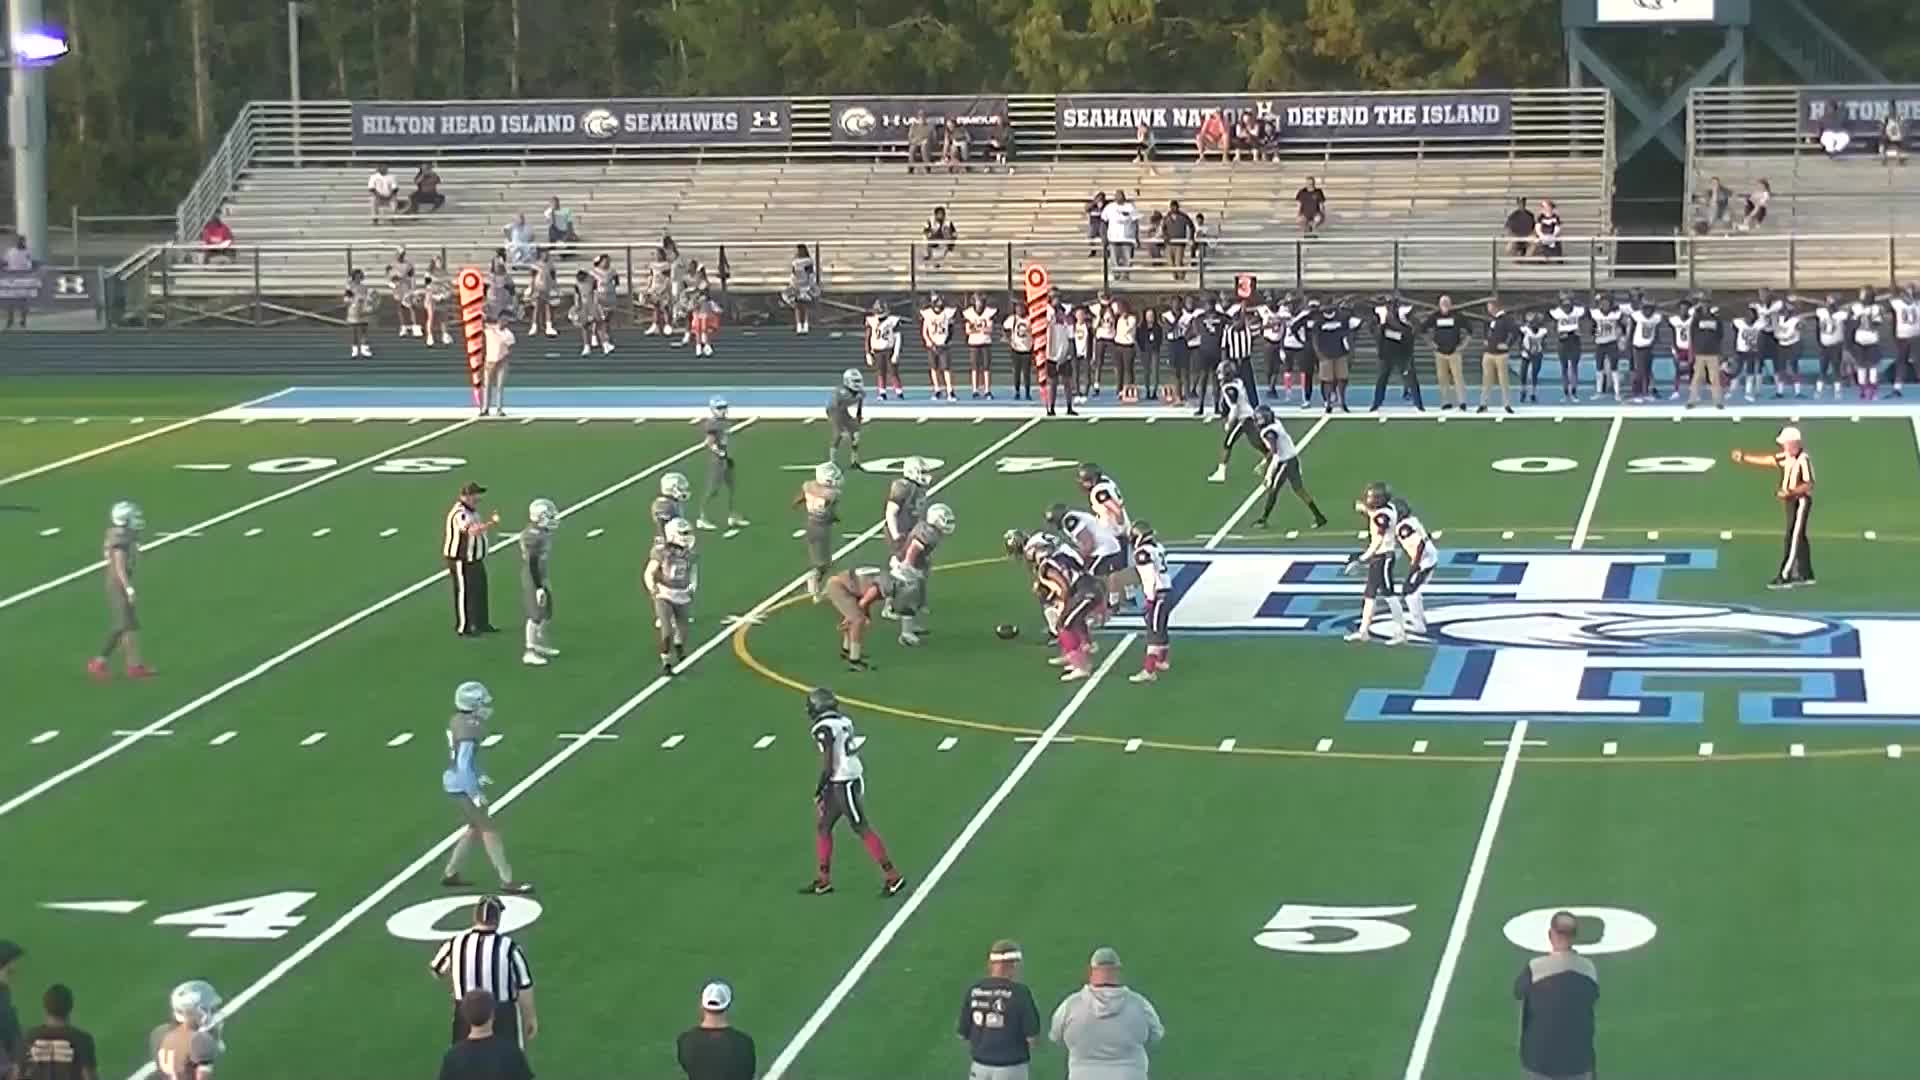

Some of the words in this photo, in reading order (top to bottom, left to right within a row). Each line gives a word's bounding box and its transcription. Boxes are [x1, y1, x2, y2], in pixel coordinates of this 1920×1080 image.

[362, 115, 436, 135] HILTON
[440, 114, 495, 134] HEAD
[500, 113, 576, 133] ISLAND
[624, 110, 739, 133] SEAHAWKS
[1063, 108, 1167, 129] SEAHAWK
[1287, 106, 1370, 127] DEFEND
[1374, 106, 1417, 125] THE
[1421, 105, 1501, 125] ISLAND
[1238, 277, 1252, 298] 3
